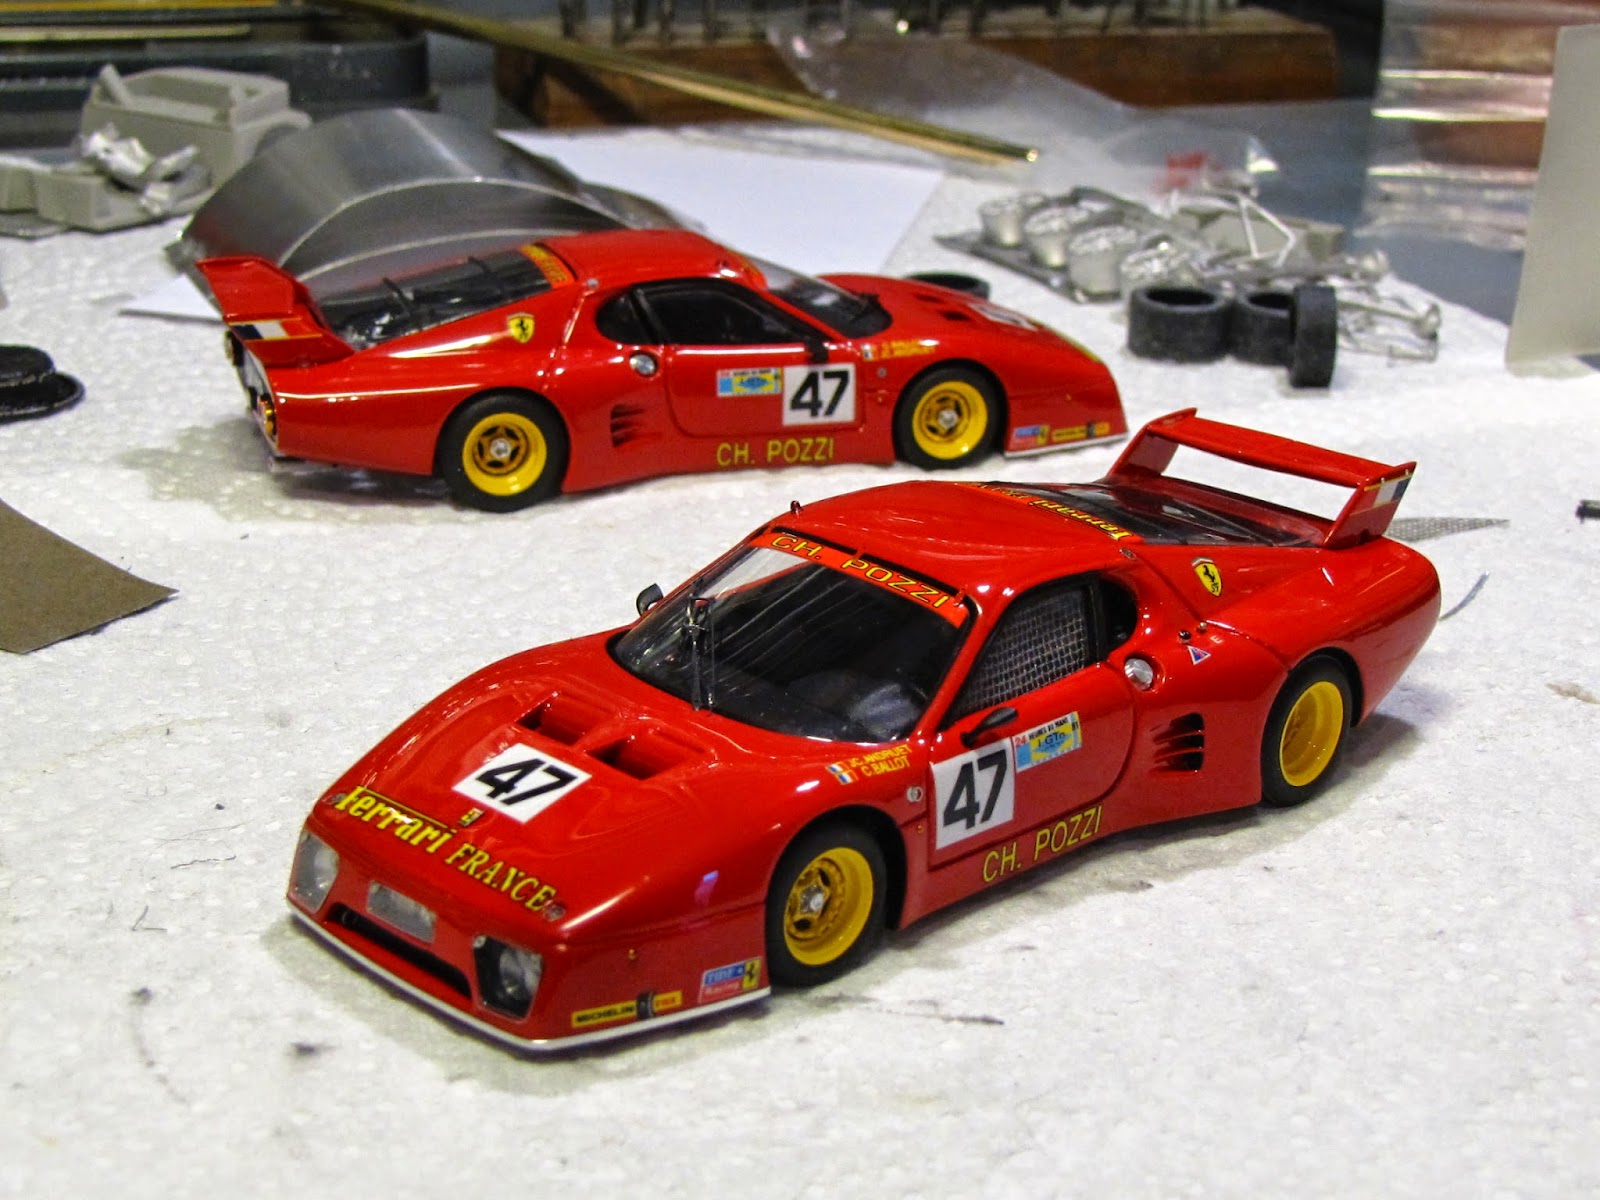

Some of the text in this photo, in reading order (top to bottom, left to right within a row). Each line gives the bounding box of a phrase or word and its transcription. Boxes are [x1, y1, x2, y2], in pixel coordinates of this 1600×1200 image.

[790, 369, 849, 417] 47
[716, 437, 834, 467] CH. POZZI
[770, 534, 950, 609] CH. POZZI
[1014, 734, 1027, 748] 24
[475, 758, 579, 806] 47
[943, 749, 1008, 830] 47
[334, 786, 557, 912] Ferrari FRANCE
[982, 804, 1104, 884] CH. POZZI
